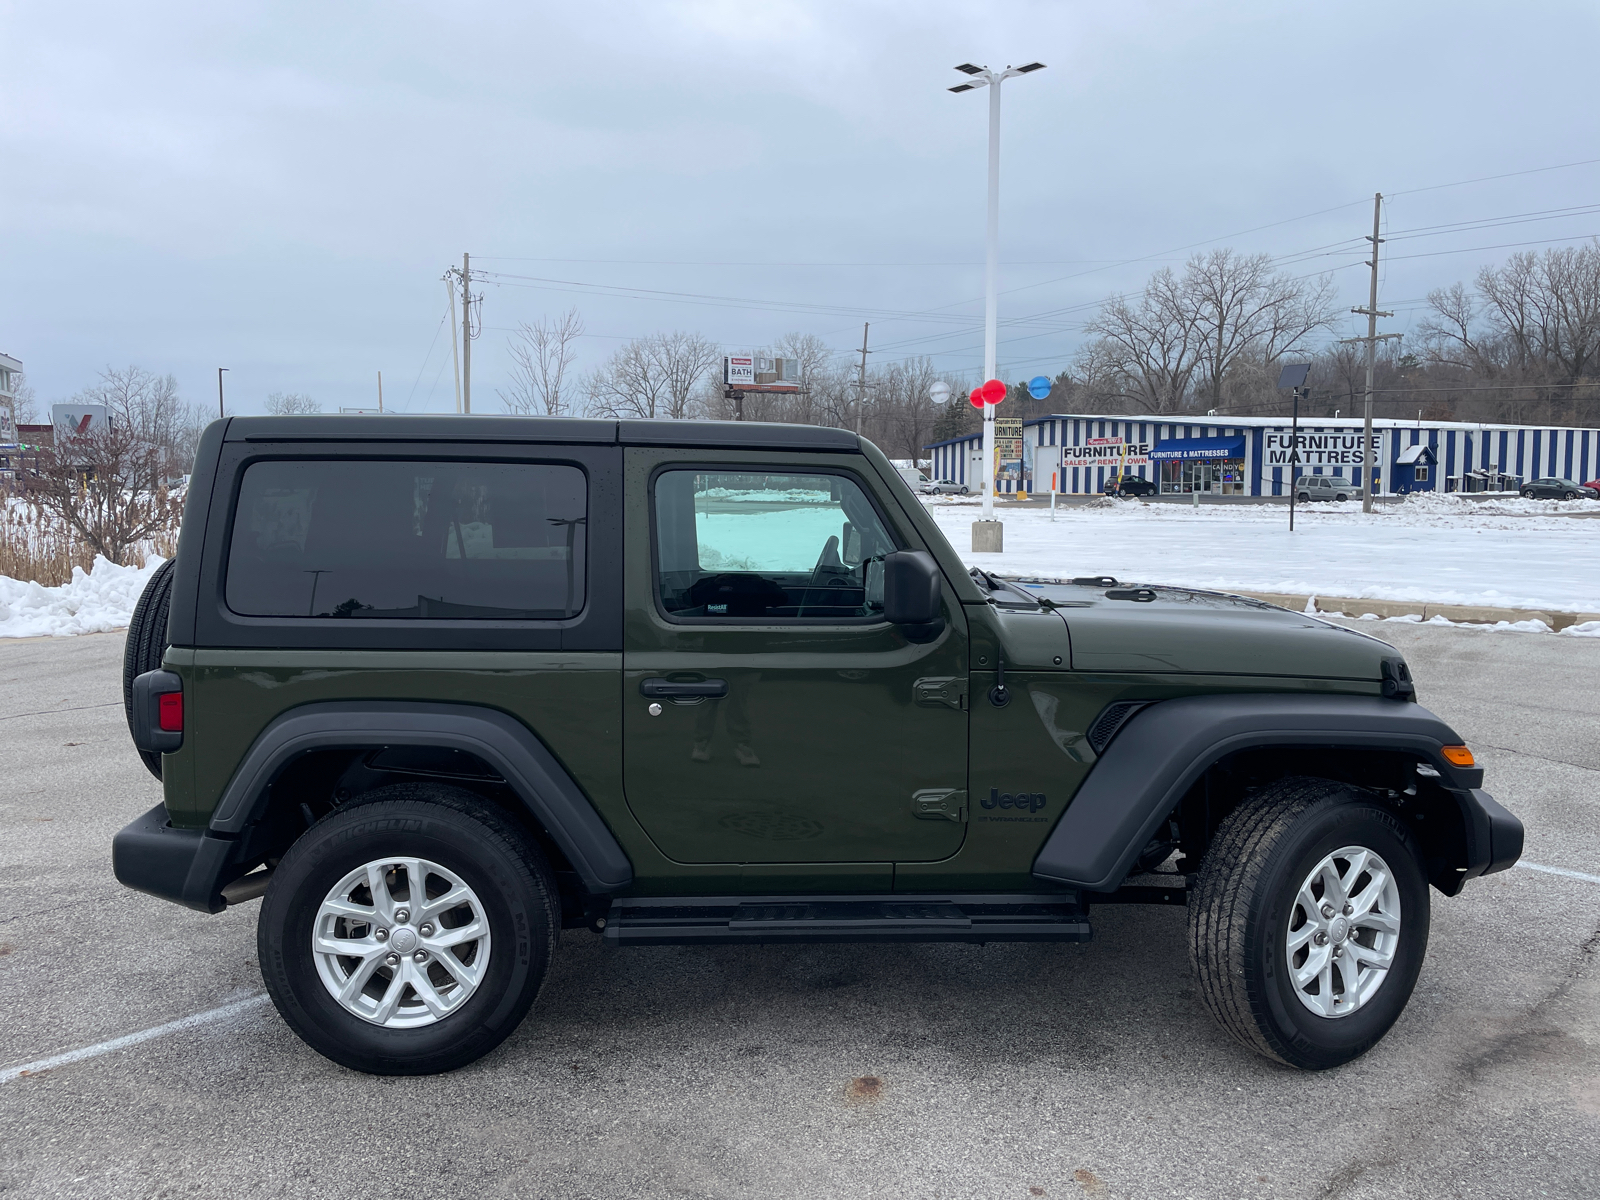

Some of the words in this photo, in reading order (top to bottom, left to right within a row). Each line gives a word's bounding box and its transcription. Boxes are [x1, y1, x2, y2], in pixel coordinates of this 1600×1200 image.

[994, 426, 1022, 436] URNITURE
[1064, 444, 1149, 458] FURNITURE
[1150, 450, 1182, 458] FURNITURE
[1189, 449, 1229, 457] MATTRESSES
[980, 786, 1047, 813] Jeep
[331, 818, 423, 847] MICHELIN
